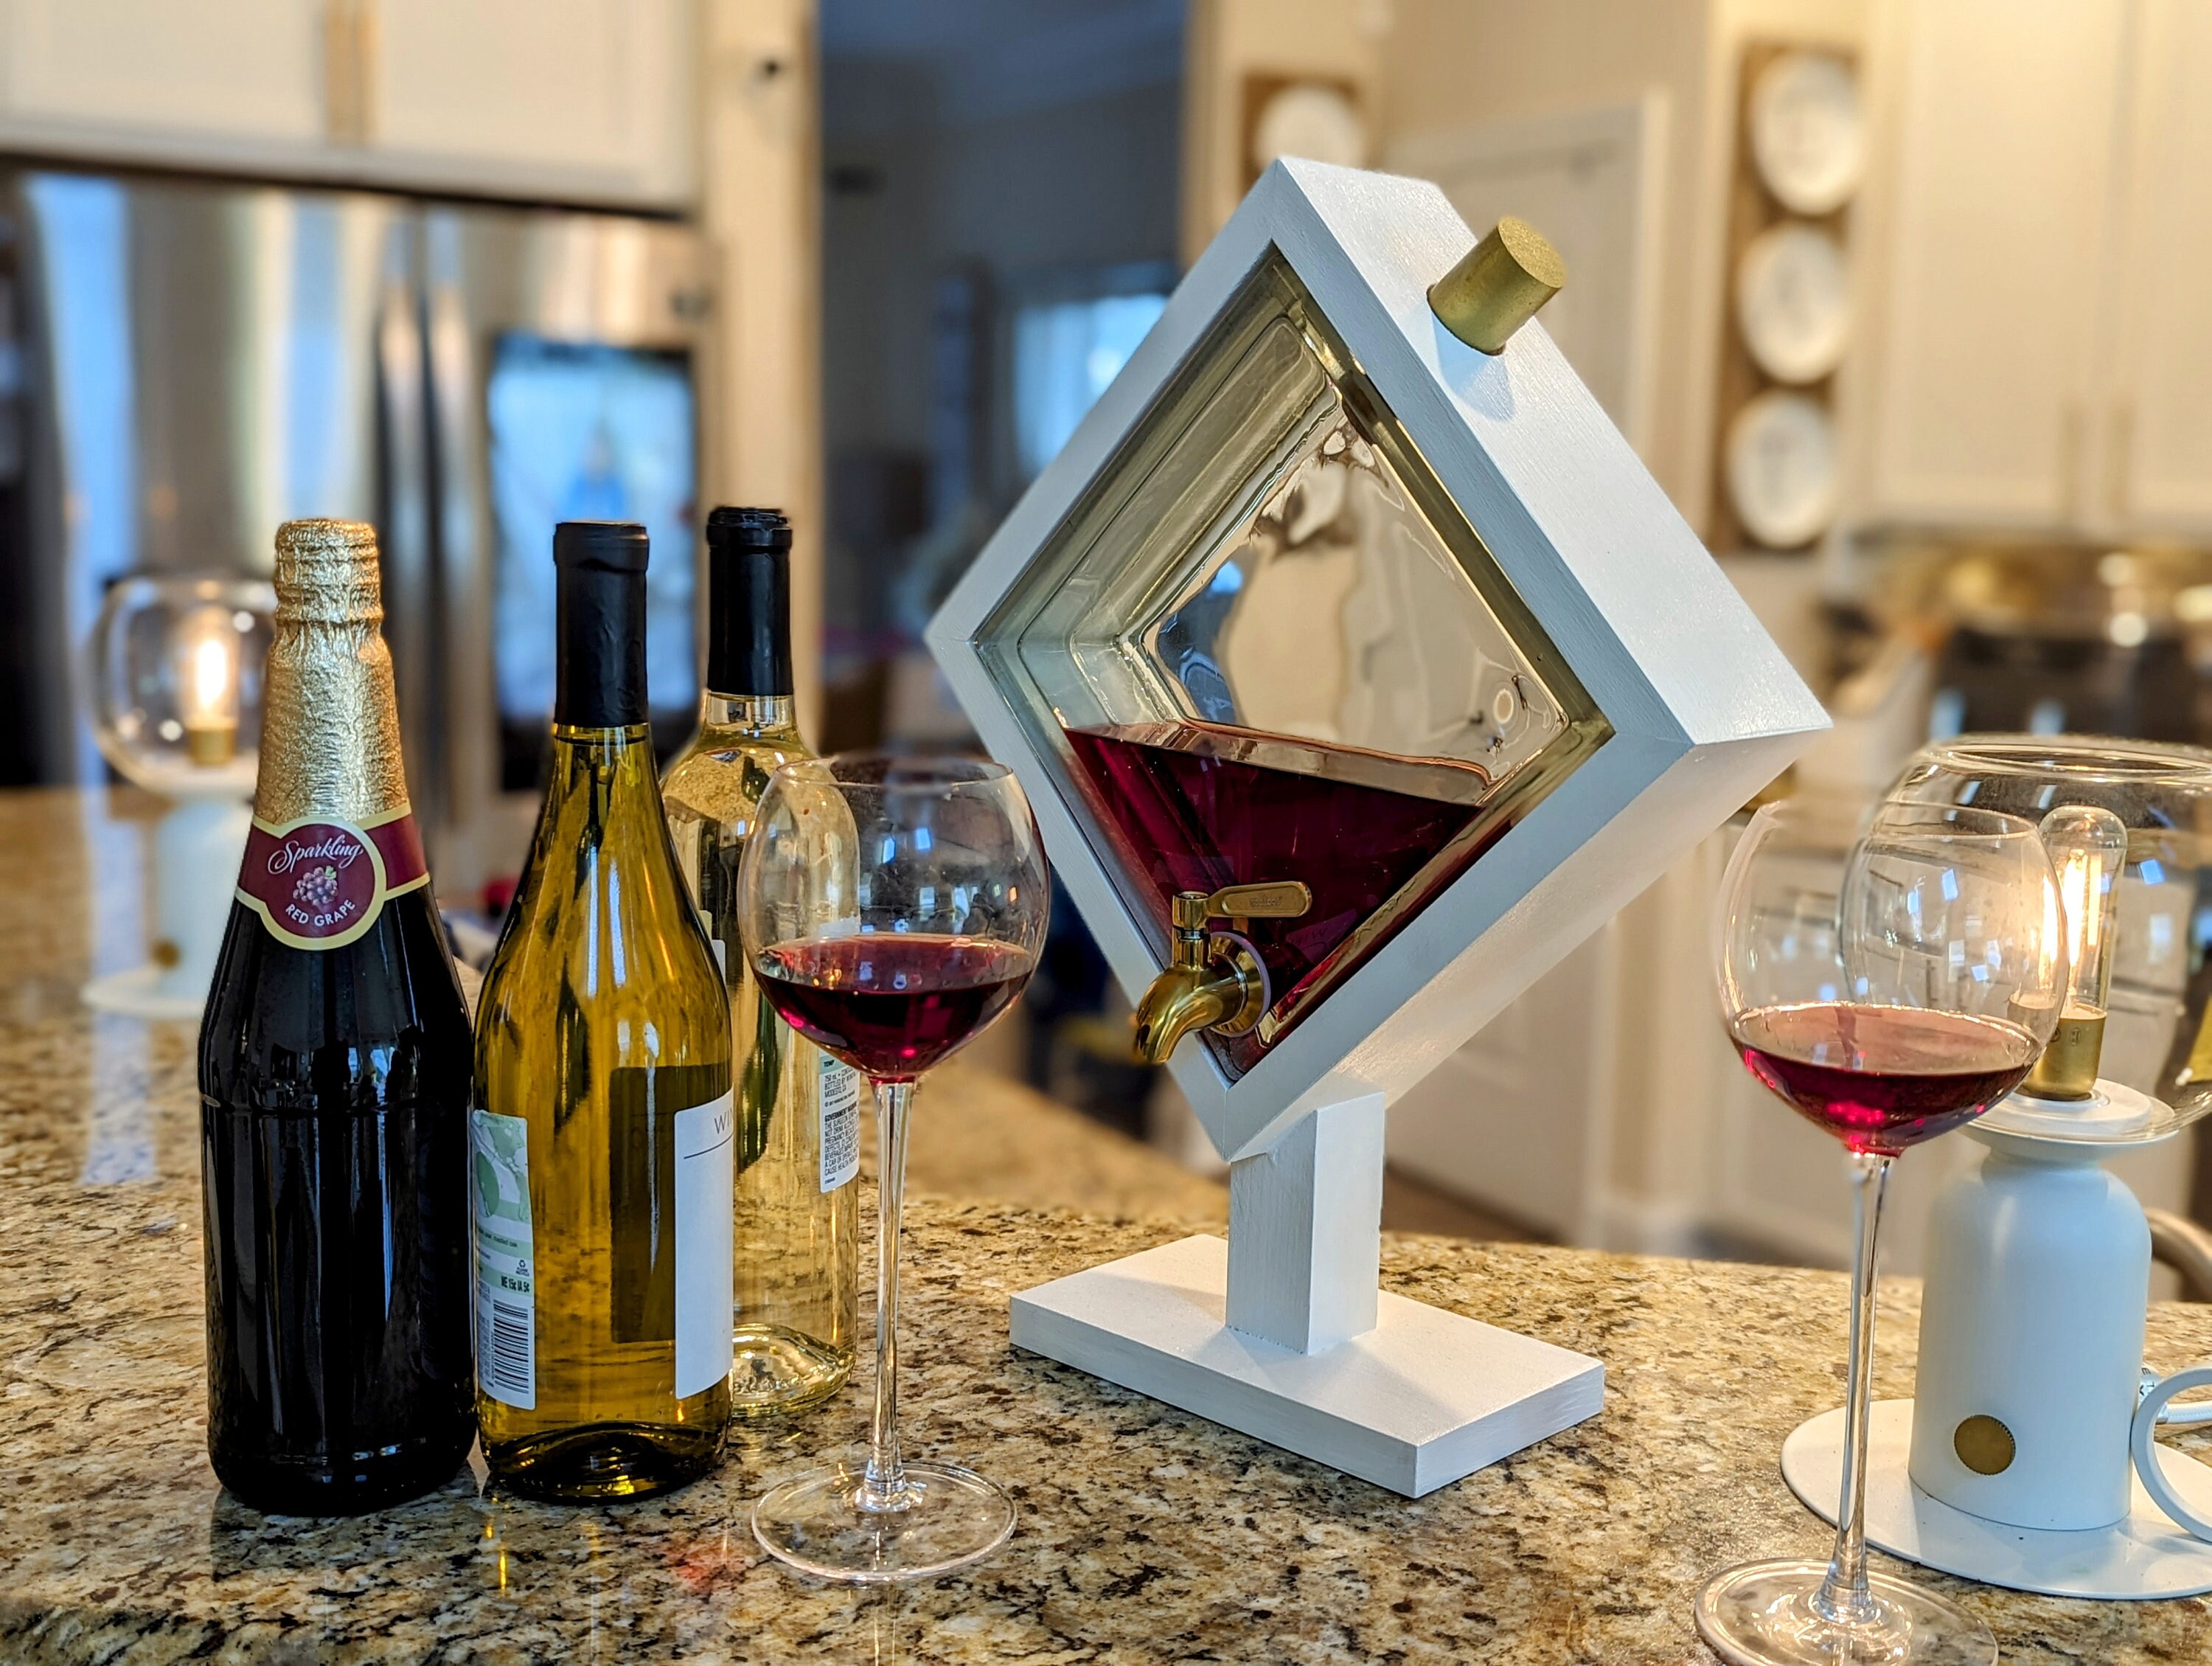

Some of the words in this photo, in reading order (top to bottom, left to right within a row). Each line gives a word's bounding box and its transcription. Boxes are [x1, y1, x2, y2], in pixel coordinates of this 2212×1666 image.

[268, 834, 364, 875] Sparkling
[285, 903, 309, 924] RED
[314, 900, 355, 926] GRAPE
